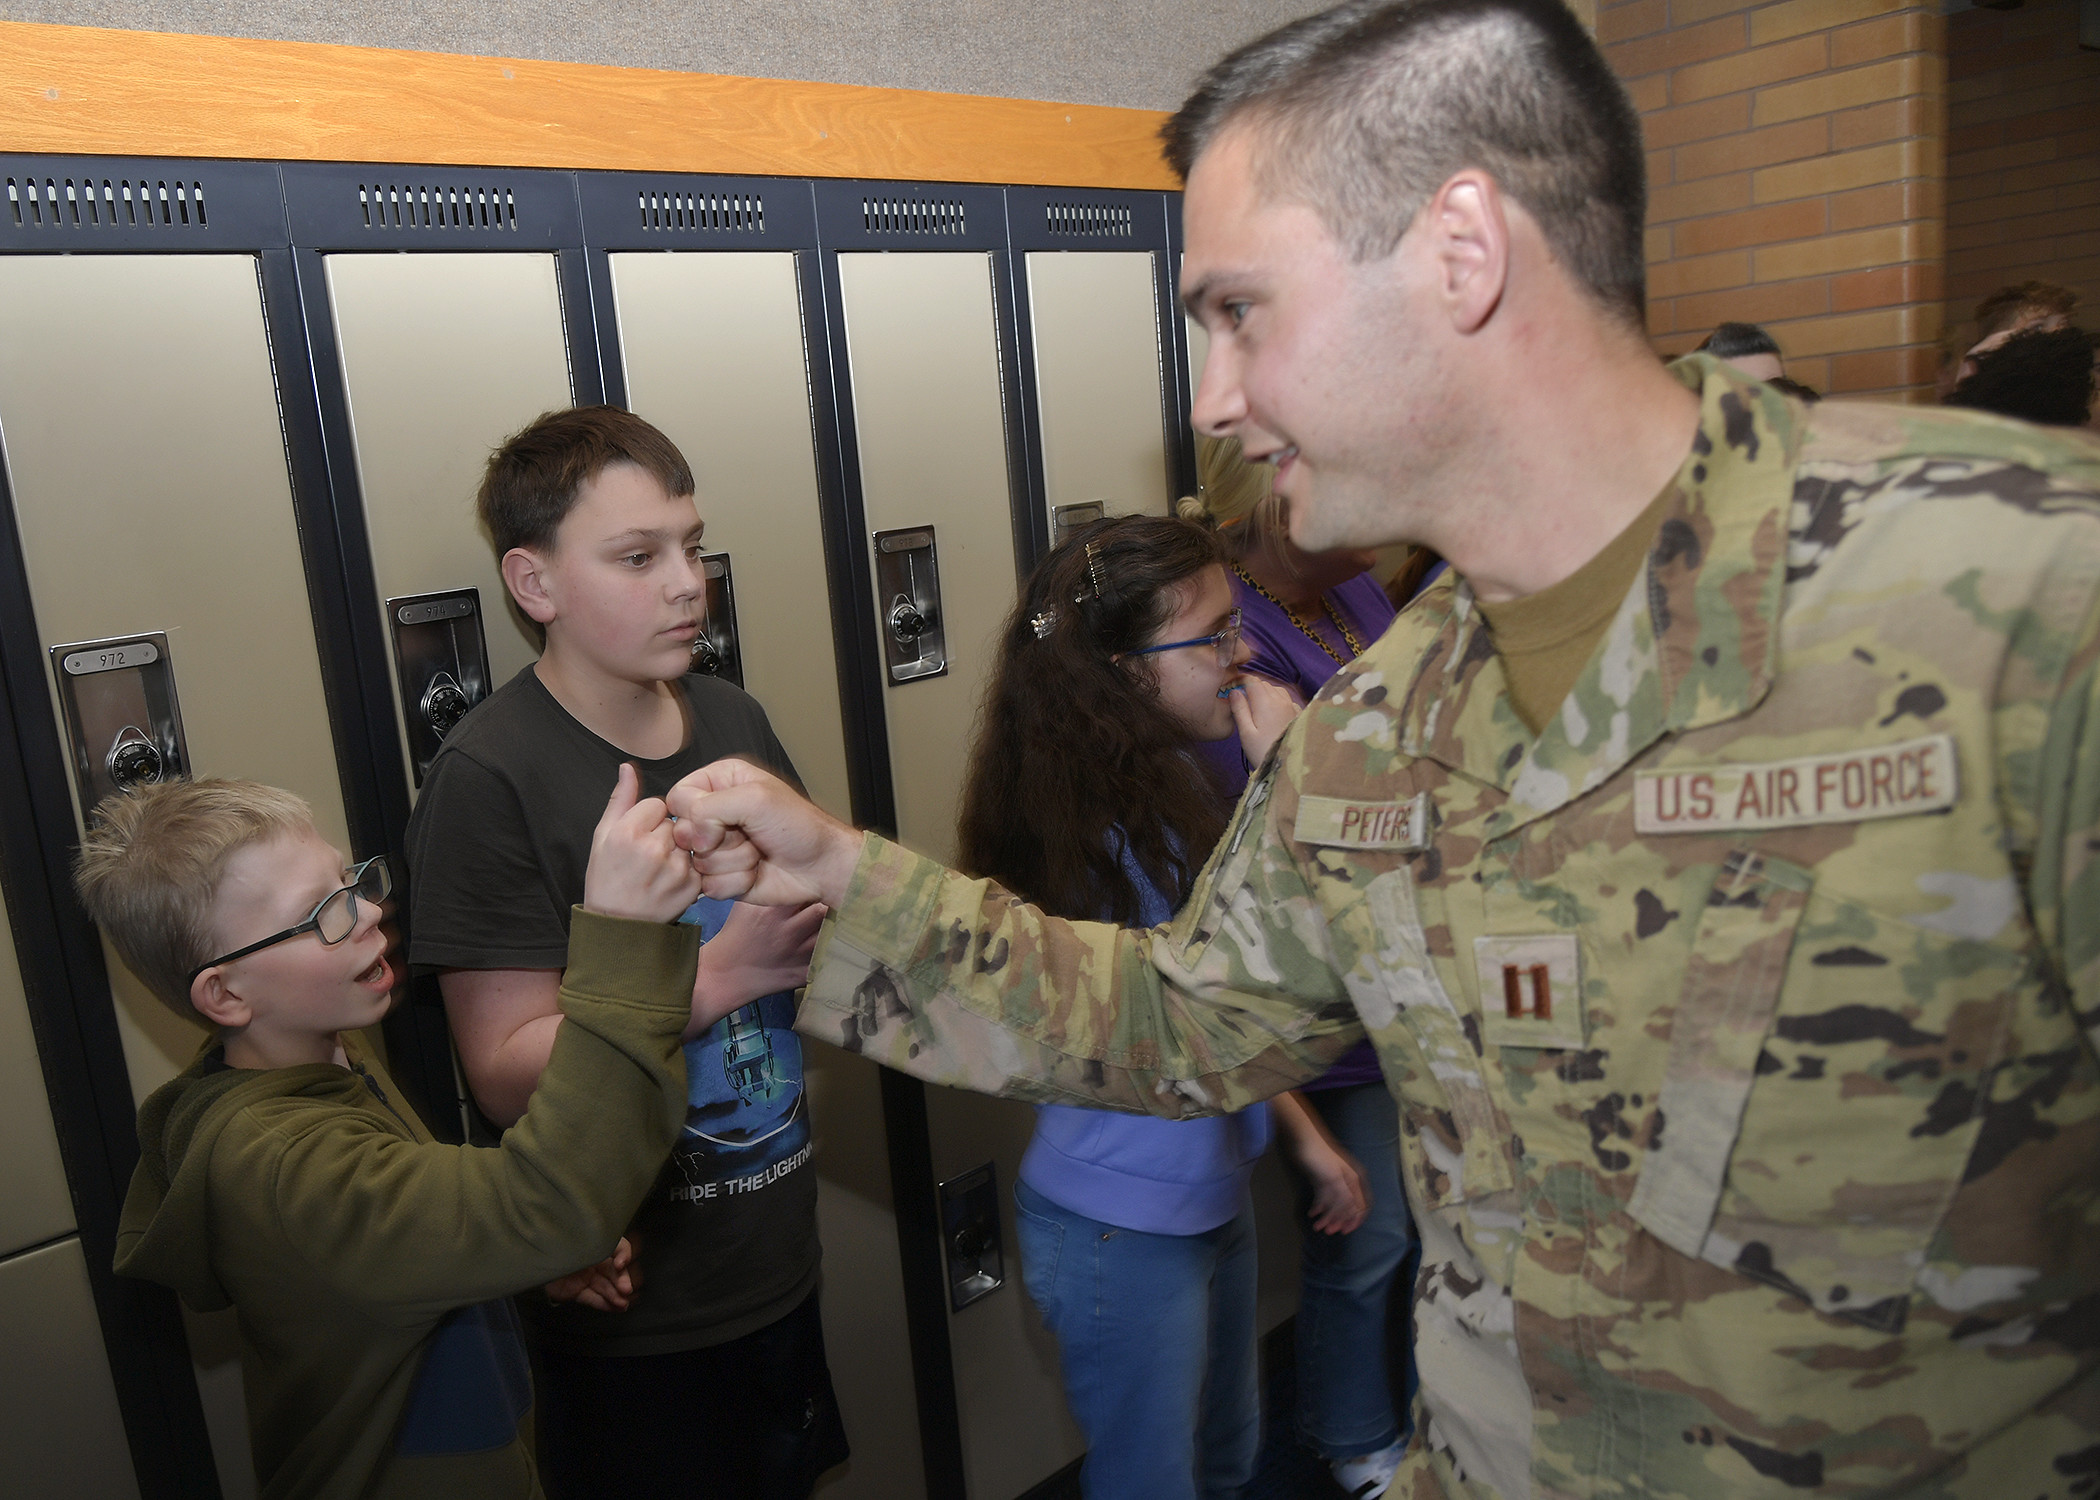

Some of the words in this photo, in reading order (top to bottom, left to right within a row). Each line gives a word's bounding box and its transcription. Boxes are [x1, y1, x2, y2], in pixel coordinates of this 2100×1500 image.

[427, 604, 446, 618] 974
[100, 652, 126, 667] 972
[1656, 773, 1721, 821] U.S.
[1735, 767, 1801, 821] AIR
[1815, 747, 1941, 812] FORCE
[1341, 806, 1412, 842] PETERS
[670, 1182, 718, 1202] RIDE
[725, 1172, 764, 1196] THE
